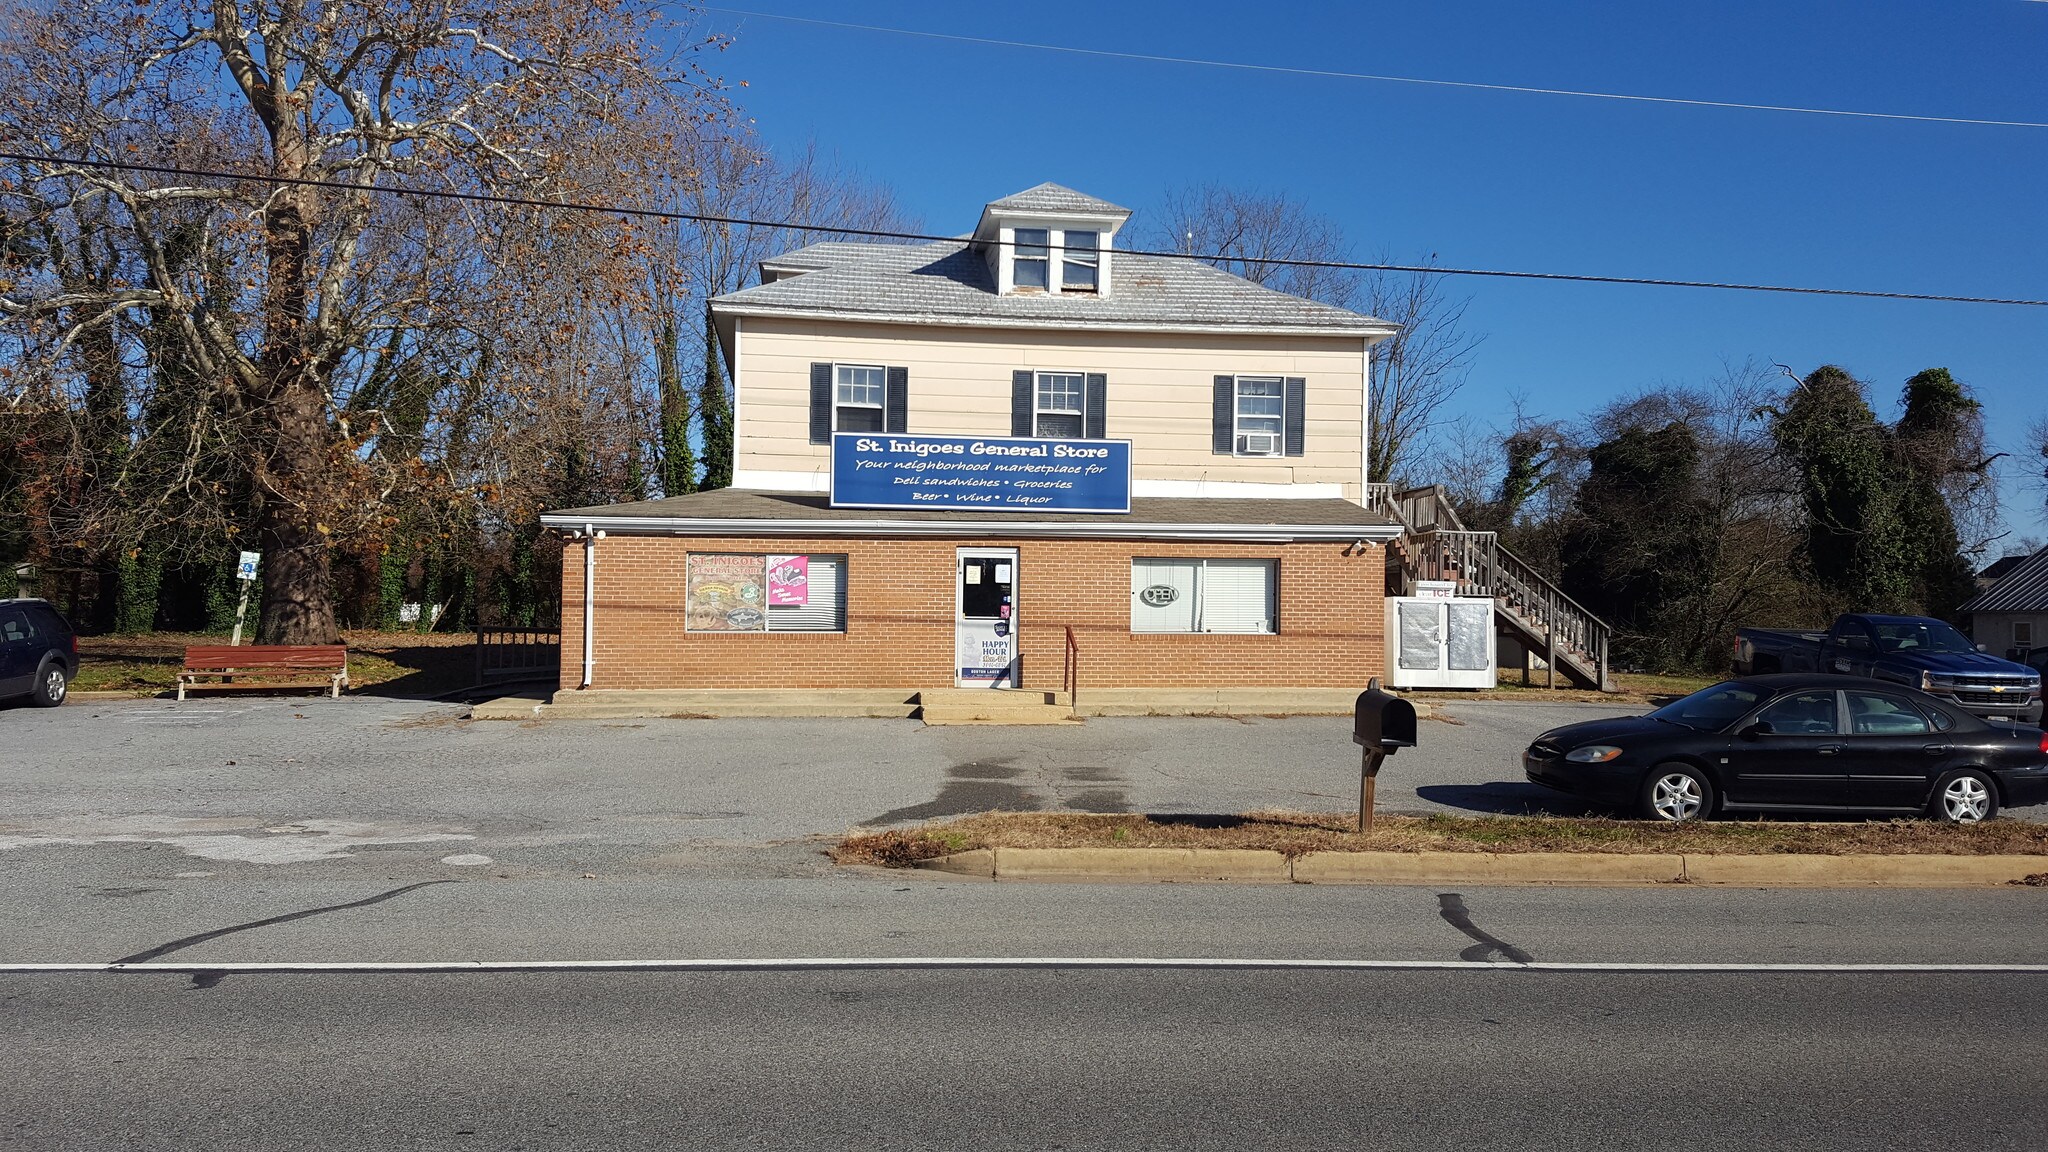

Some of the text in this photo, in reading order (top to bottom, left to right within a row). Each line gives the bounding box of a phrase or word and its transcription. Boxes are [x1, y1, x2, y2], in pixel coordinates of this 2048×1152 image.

[856, 438, 1109, 459] St. Inigoes General Store
[855, 458, 1107, 476] Your neighborhood marketplace for
[893, 475, 1073, 489] Deli sandwiches Groceries
[912, 491, 1053, 506] Beer Wine Liquor
[691, 557, 709, 566] ST.
[713, 557, 764, 567] INIGOES
[694, 567, 732, 575] GENERAL
[1144, 588, 1176, 602] OPEN
[1433, 589, 1451, 598] ICE
[982, 640, 1009, 648] HAPPY
[982, 648, 1007, 656] HOUR
